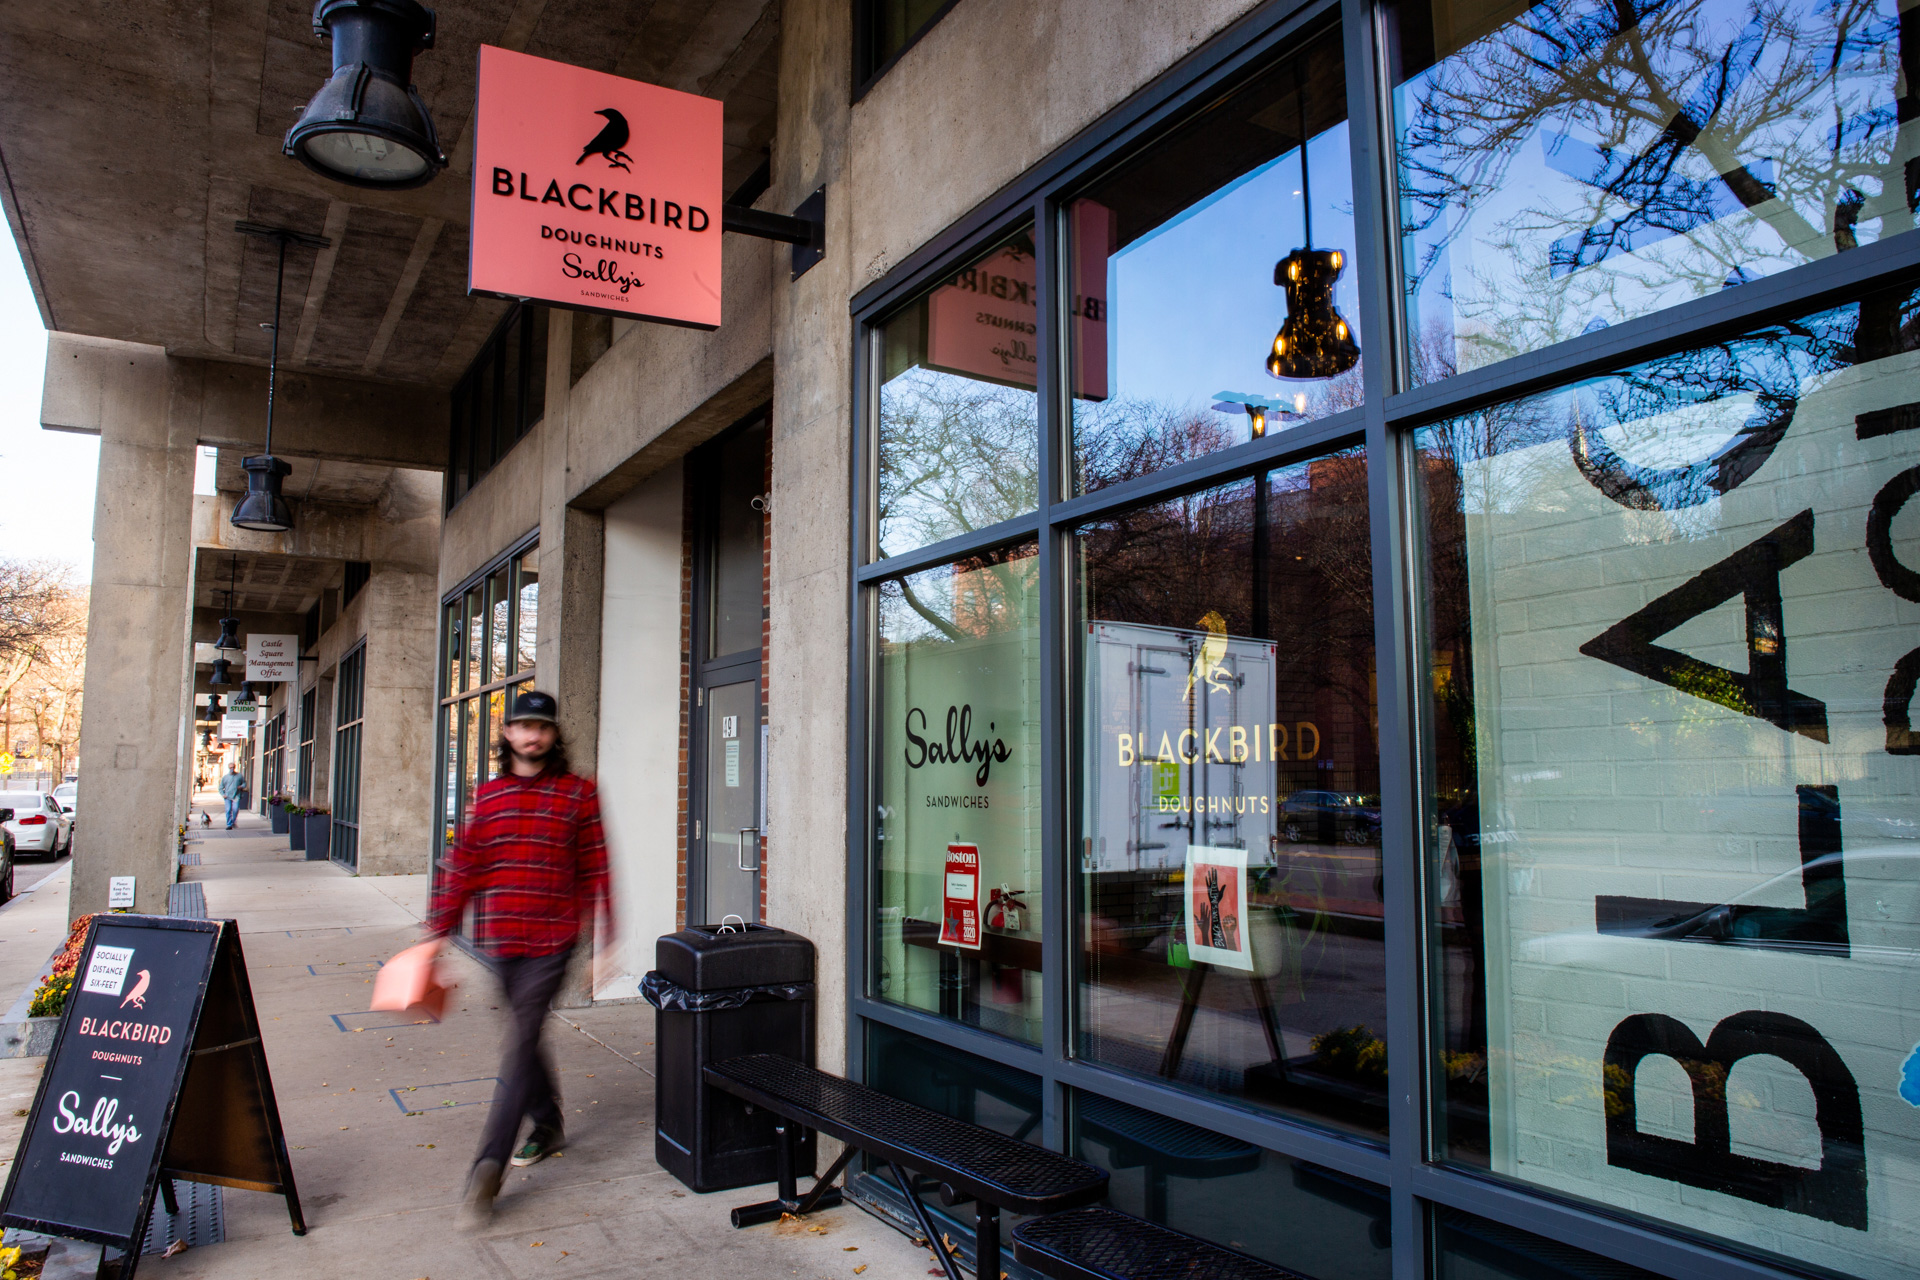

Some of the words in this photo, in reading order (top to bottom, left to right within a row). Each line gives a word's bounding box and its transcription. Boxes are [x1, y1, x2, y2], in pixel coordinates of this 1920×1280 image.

[492, 166, 710, 233] BLACKBIRD
[541, 224, 664, 260] DOUGHNUTS
[562, 252, 645, 294] Sally's
[580, 289, 630, 303] SANDWICHES
[261, 640, 283, 648] Castle
[259, 650, 284, 658] Square
[248, 660, 294, 668] Management
[260, 669, 282, 678] Office
[905, 703, 1013, 788] Sally's
[1118, 721, 1321, 768] BLACKBIRD
[926, 795, 990, 809] SANDWICHES
[1158, 795, 1270, 815] DOUGHNUTS
[946, 850, 976, 864] Boston
[963, 926, 976, 938] 2020
[96, 951, 129, 962] SOCIALLY
[92, 964, 124, 976] DISTANCE
[90, 978, 118, 989] SIX-FEET
[79, 1016, 172, 1045] BLACKBIRD
[91, 1050, 143, 1066] DOUGHNUTS
[53, 1090, 142, 1155] Sally's
[60, 1152, 114, 1170] SANDWICHES
